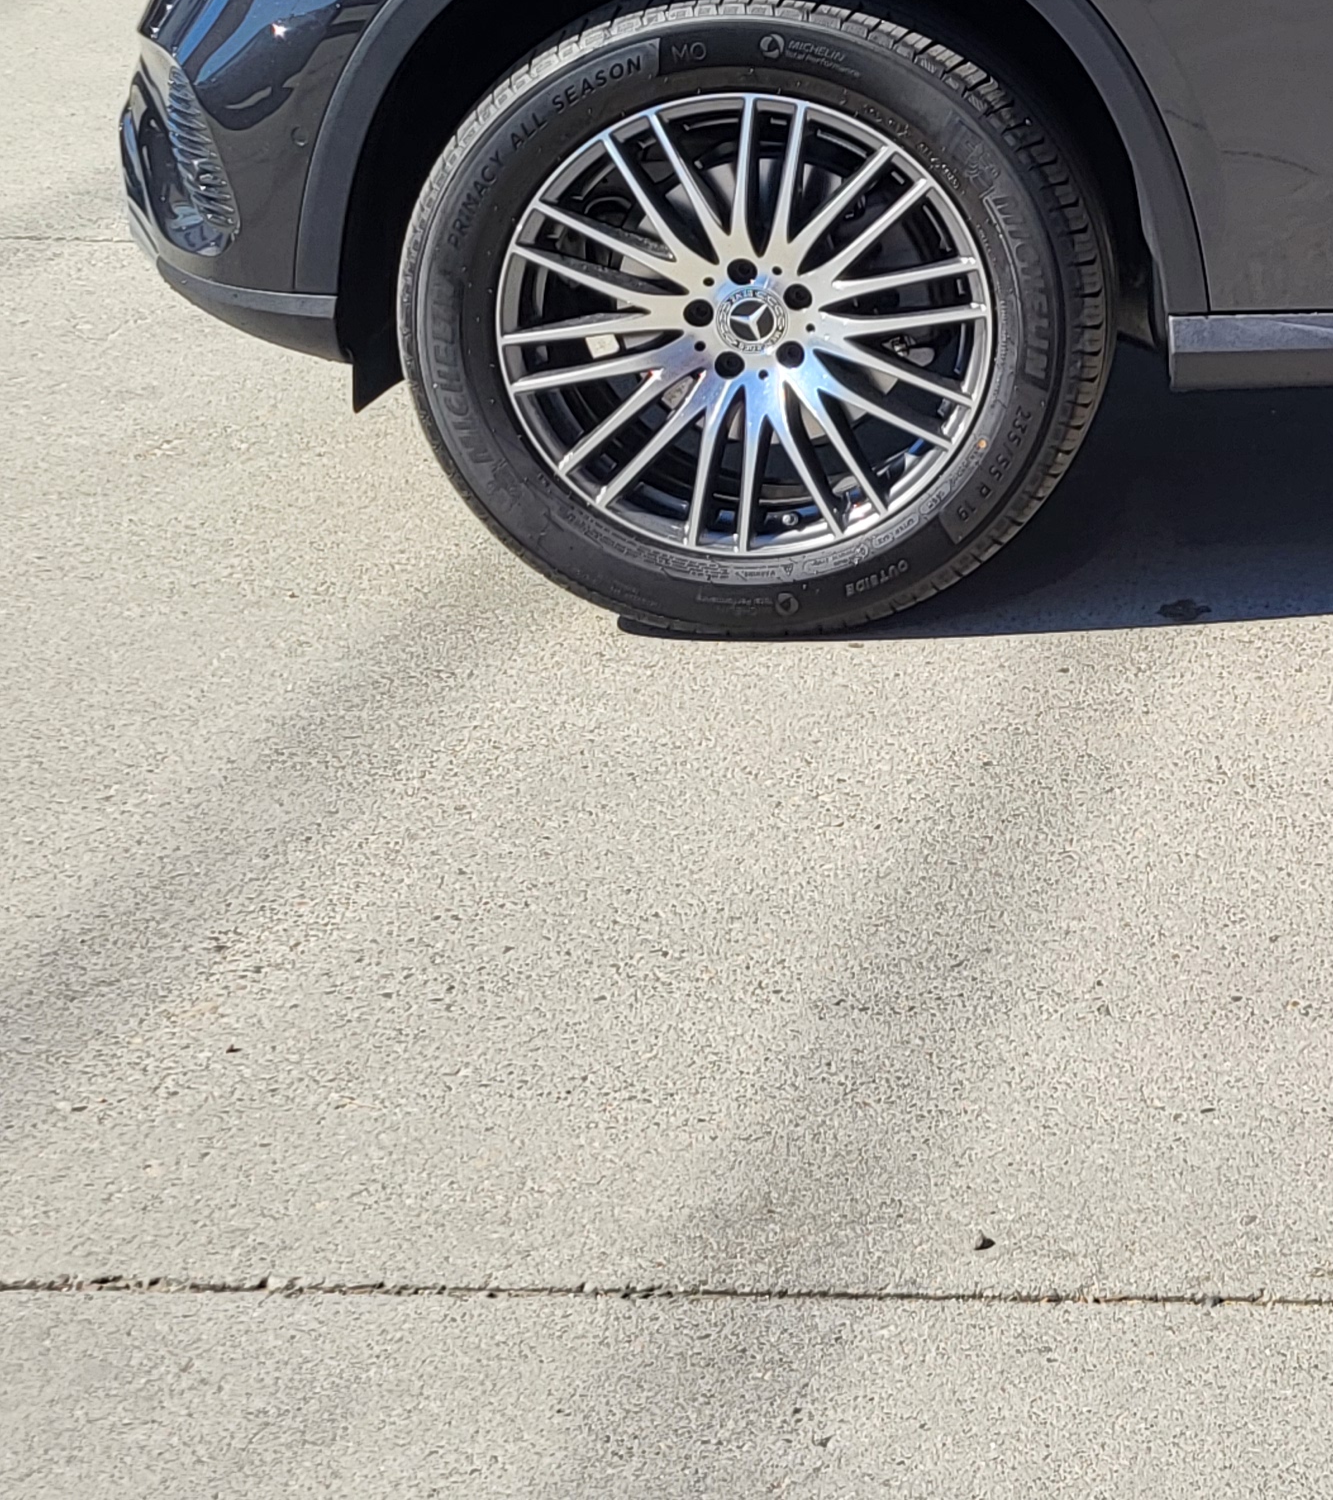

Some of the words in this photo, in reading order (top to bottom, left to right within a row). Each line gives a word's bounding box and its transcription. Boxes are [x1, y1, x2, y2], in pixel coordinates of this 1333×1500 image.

[671, 42, 707, 63] MO
[448, 149, 505, 249] PRIMACY
[510, 112, 548, 150] ALL
[551, 54, 642, 114] SEASON
[988, 404, 1032, 483] 235/55
[956, 503, 977, 522] 19
[845, 559, 909, 597] OUTSIDE
